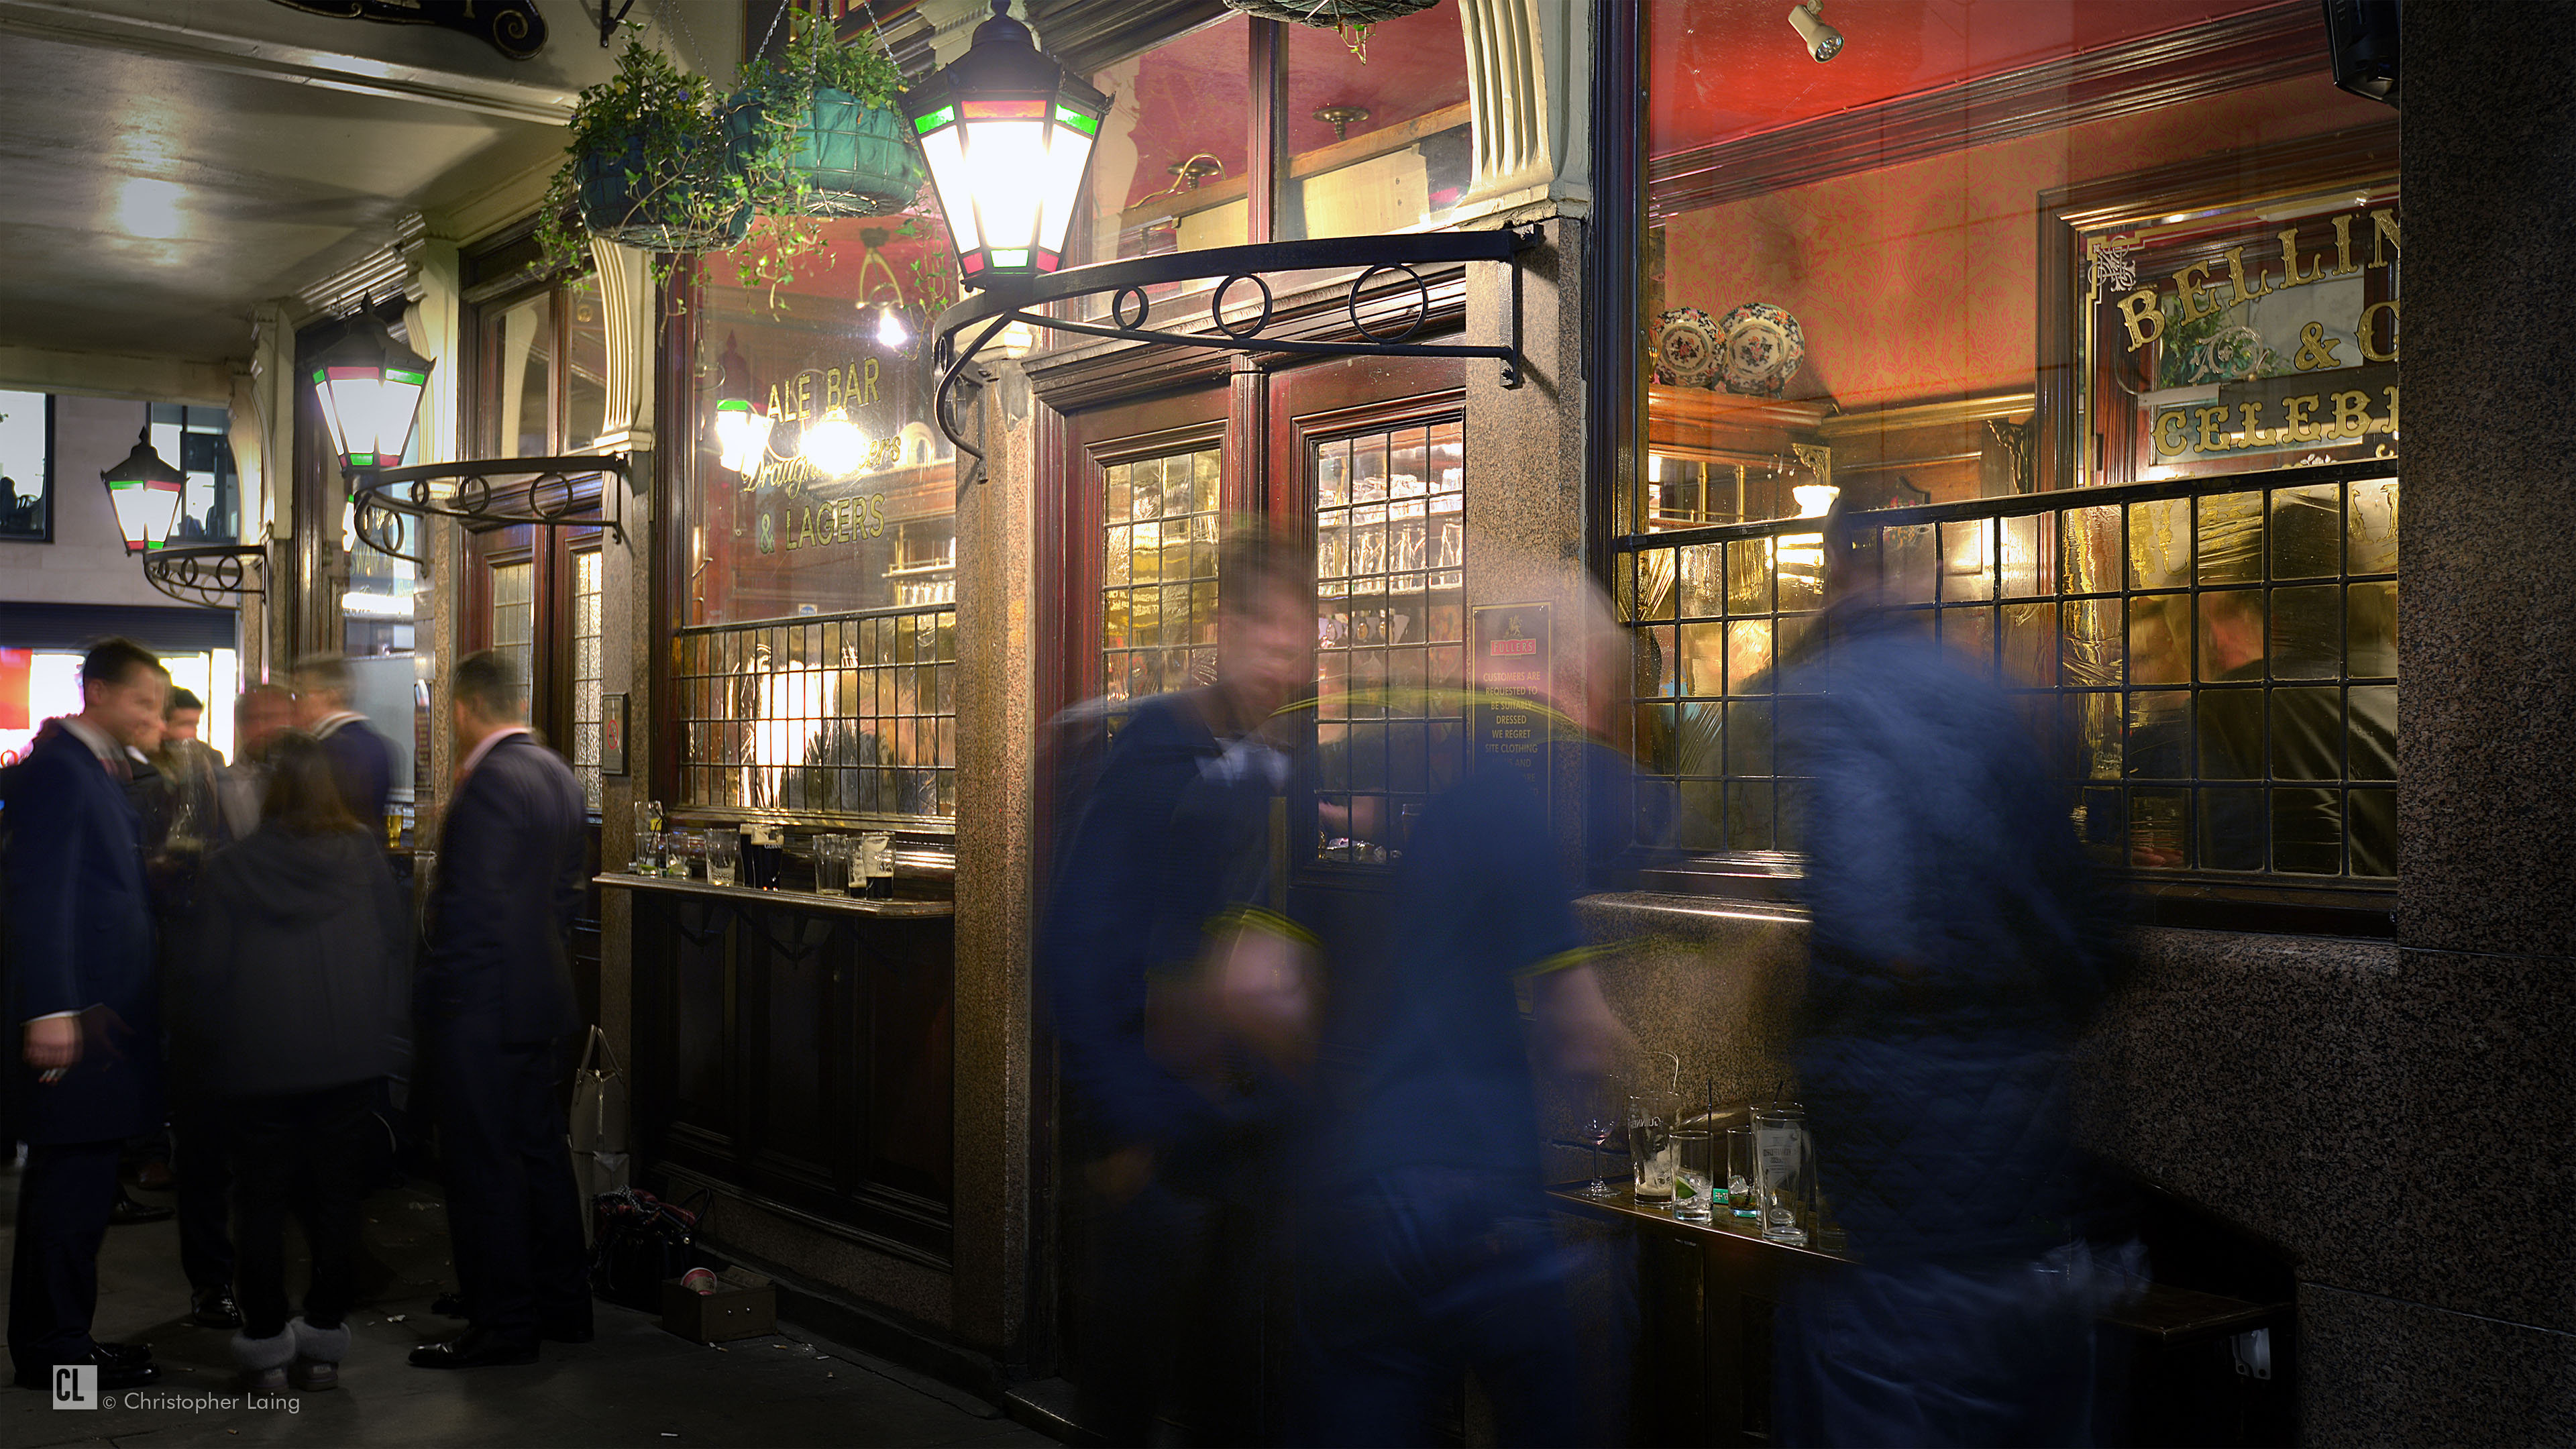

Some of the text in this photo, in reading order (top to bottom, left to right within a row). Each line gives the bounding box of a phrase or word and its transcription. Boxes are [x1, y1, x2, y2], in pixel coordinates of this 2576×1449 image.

[2294, 321, 2341, 372] &
[766, 357, 881, 424] ALE BAR
[759, 492, 885, 554] & LAGERS
[1493, 641, 1534, 653] FULLER'S
[1483, 671, 1541, 682] CUSTOMERS ARE
[1485, 686, 1538, 696] REQUESTED TO
[1491, 700, 1532, 710] BE SUITABLY
[1496, 714, 1527, 724] DRESSED
[1492, 729, 1531, 739] WE REGRET
[1485, 743, 1538, 754] SITE CLOTHING
